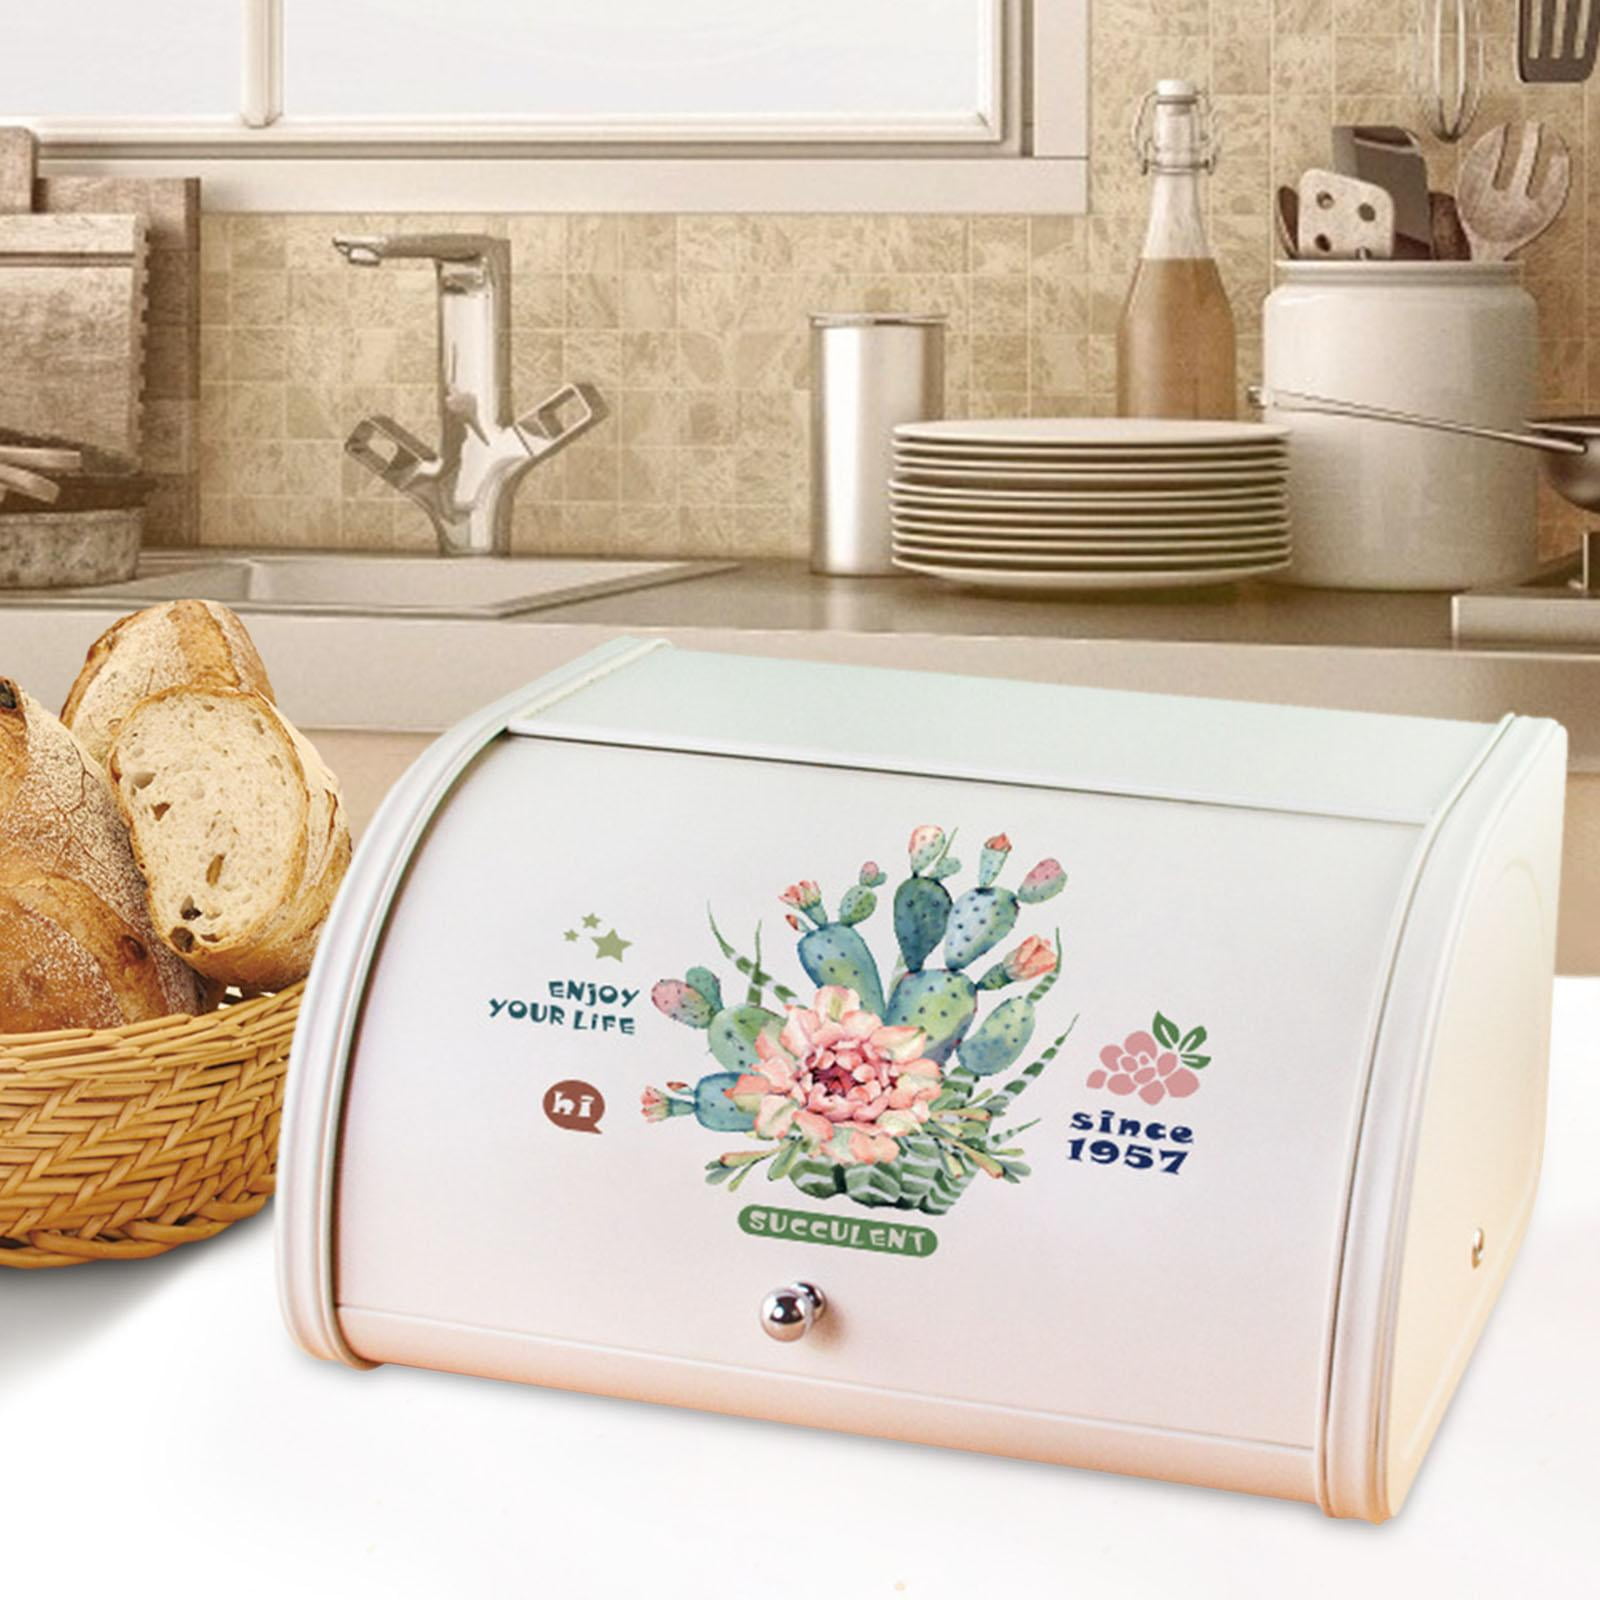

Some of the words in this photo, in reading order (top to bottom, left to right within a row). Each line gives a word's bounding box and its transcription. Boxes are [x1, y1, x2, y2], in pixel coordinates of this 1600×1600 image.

[489, 998, 565, 1025] YOUR
[552, 1090, 595, 1118] hi
[1069, 1110, 1194, 1144] since
[1067, 1138, 1190, 1175] 1957
[749, 1210, 926, 1253] SUCCULENT
